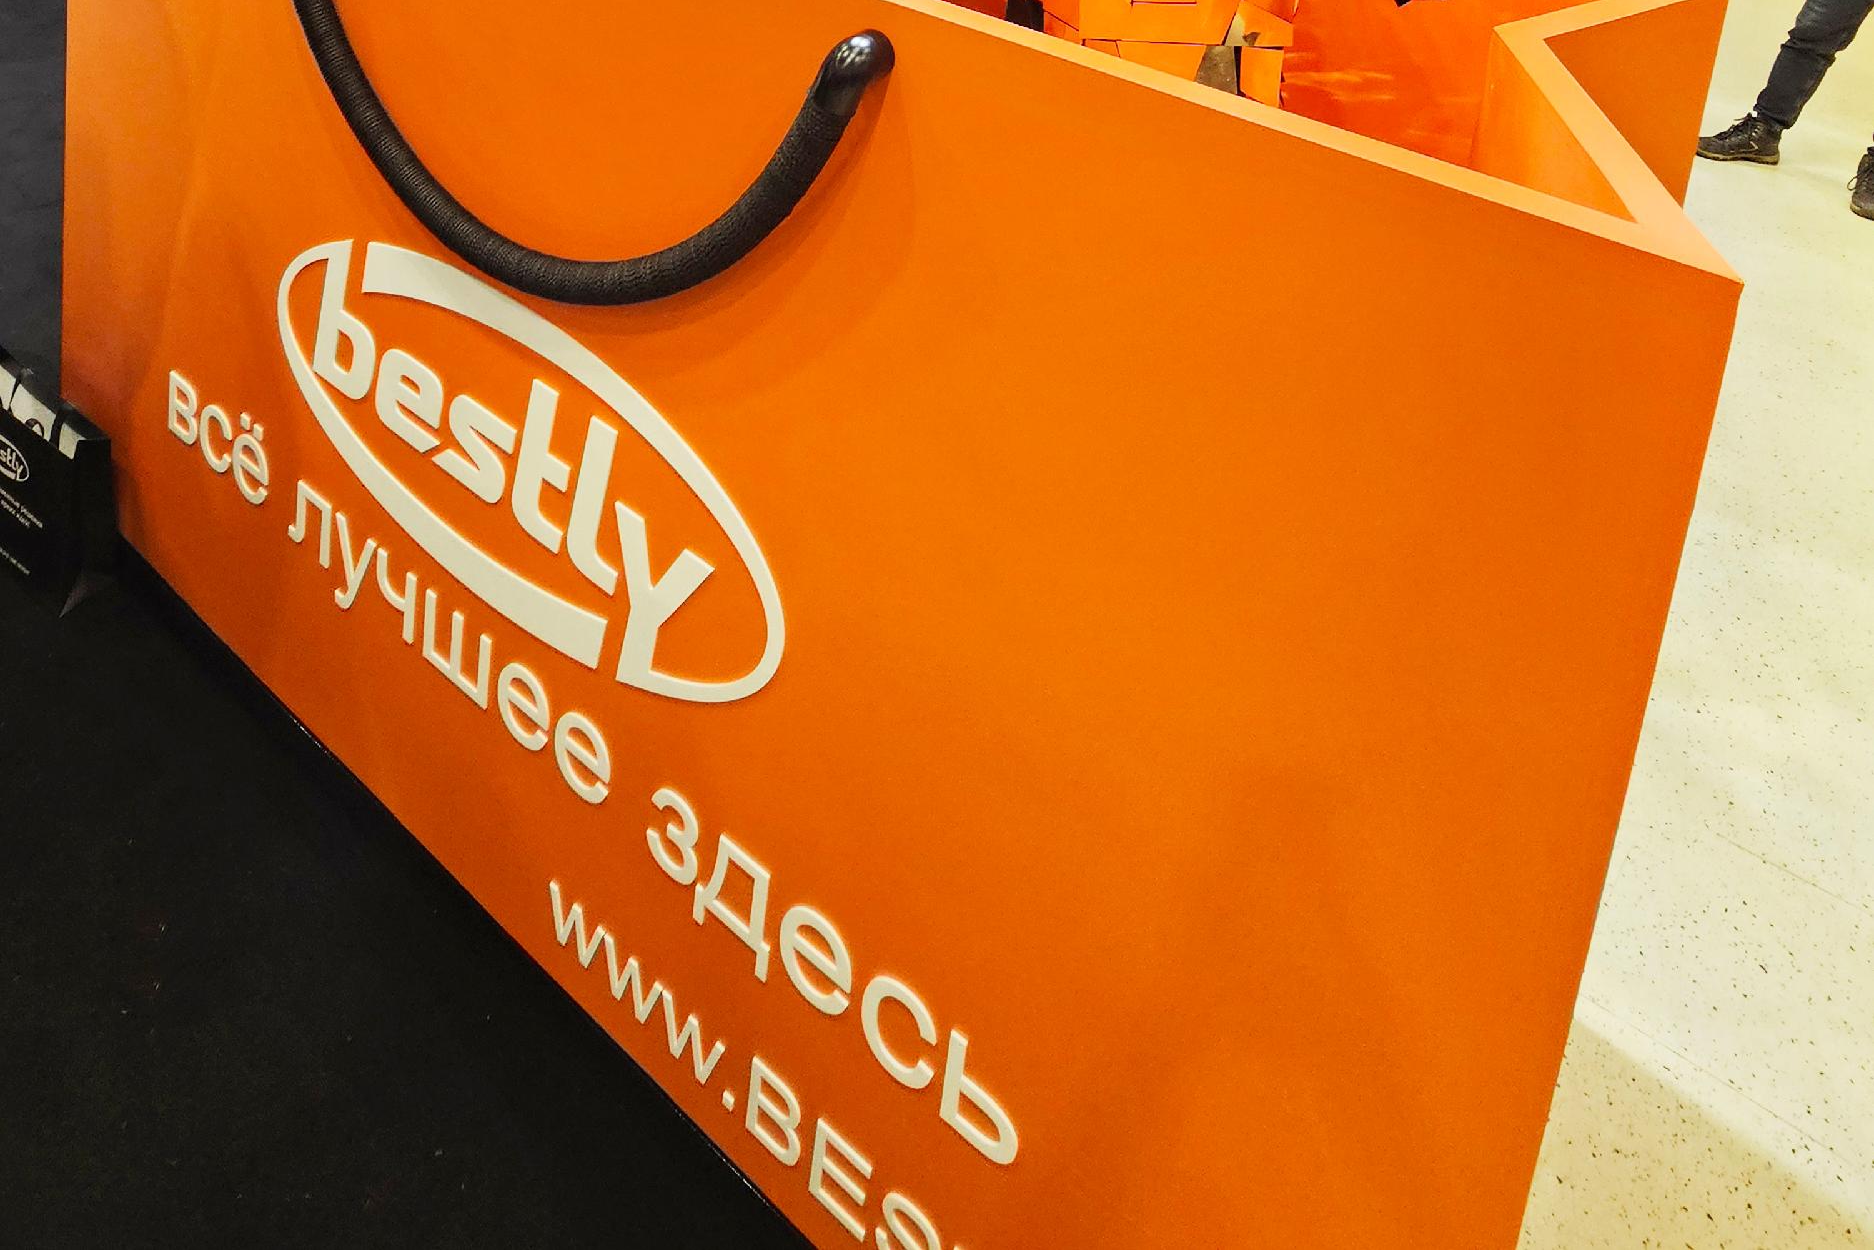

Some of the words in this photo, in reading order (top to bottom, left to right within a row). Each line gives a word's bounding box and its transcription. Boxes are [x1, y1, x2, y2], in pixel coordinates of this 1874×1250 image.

[287, 479, 612, 805] лучшее
[305, 239, 716, 683] bestly
[646, 787, 1019, 1166] здесь
